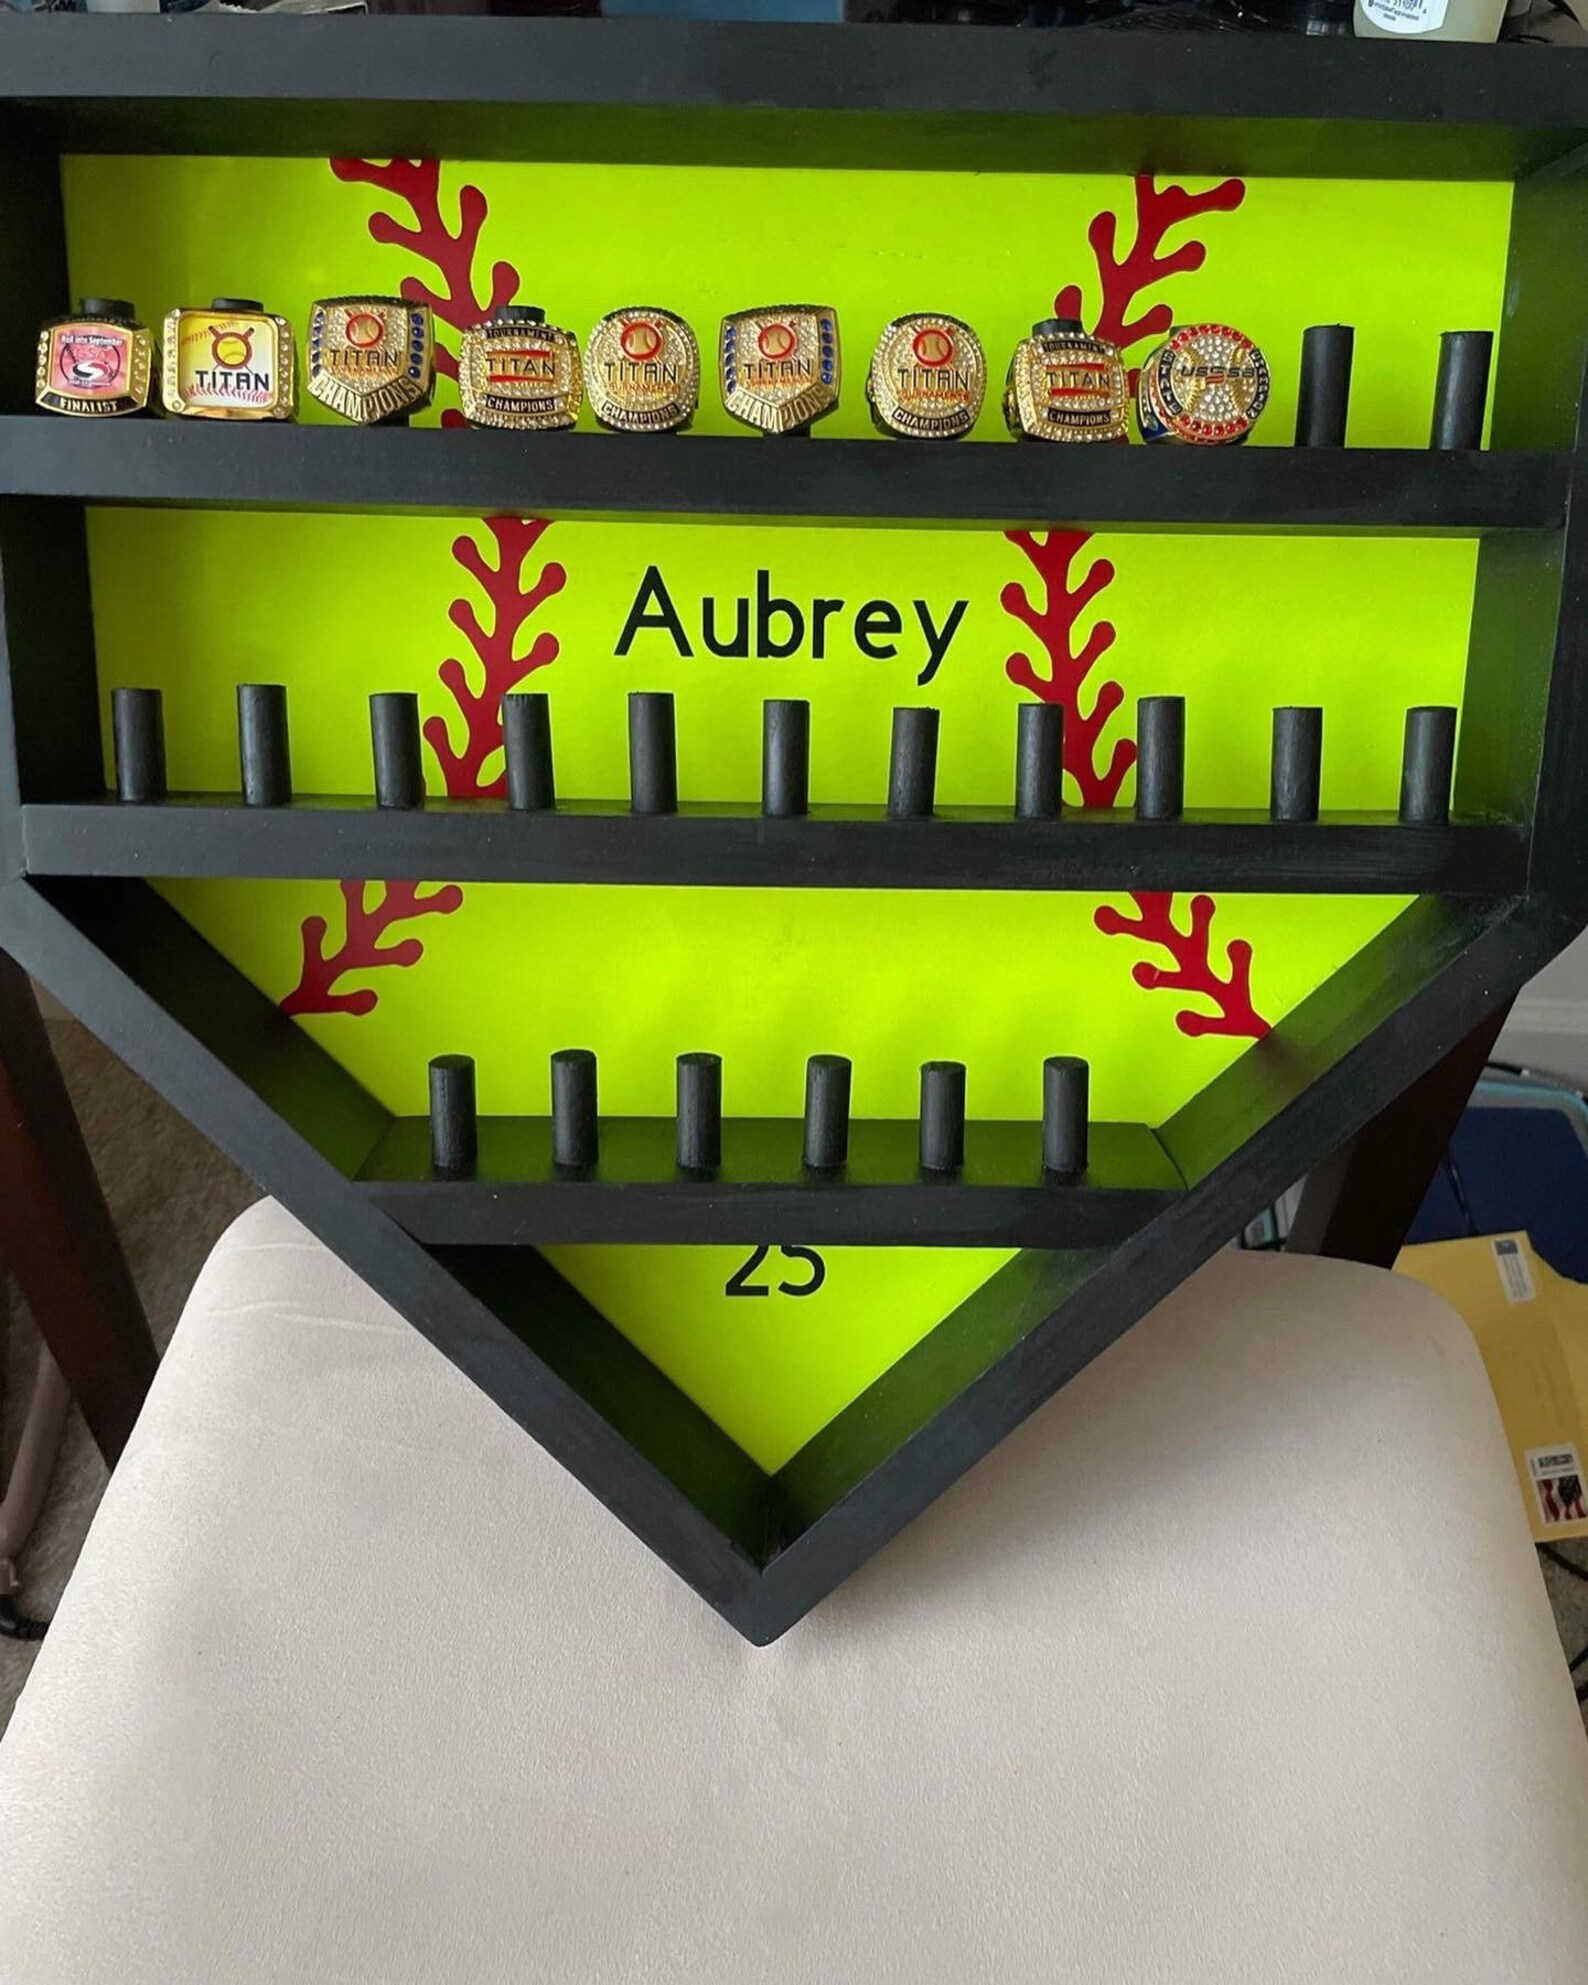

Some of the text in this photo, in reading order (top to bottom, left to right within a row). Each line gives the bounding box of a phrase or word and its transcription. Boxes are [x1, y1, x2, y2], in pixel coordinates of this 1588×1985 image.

[329, 349, 398, 366] TITAN
[486, 358, 555, 377] TITAN
[604, 362, 677, 384] TITAN
[743, 359, 811, 379] TITAN
[1180, 366, 1256, 378] USSSA
[195, 370, 270, 391] TITAN
[897, 368, 969, 391] TITAN
[1046, 371, 1111, 388] TITAN
[60, 398, 118, 412] FINALIST
[307, 376, 422, 423] CHAMPIONS
[487, 396, 556, 413] CHAMPIONS
[602, 401, 681, 424] CHAMPIONS
[893, 409, 970, 430] CHAMPIONS
[1049, 411, 1110, 426] CHAMPIONS
[613, 565, 970, 686] Aubrey
[725, 1245, 826, 1296] 25
